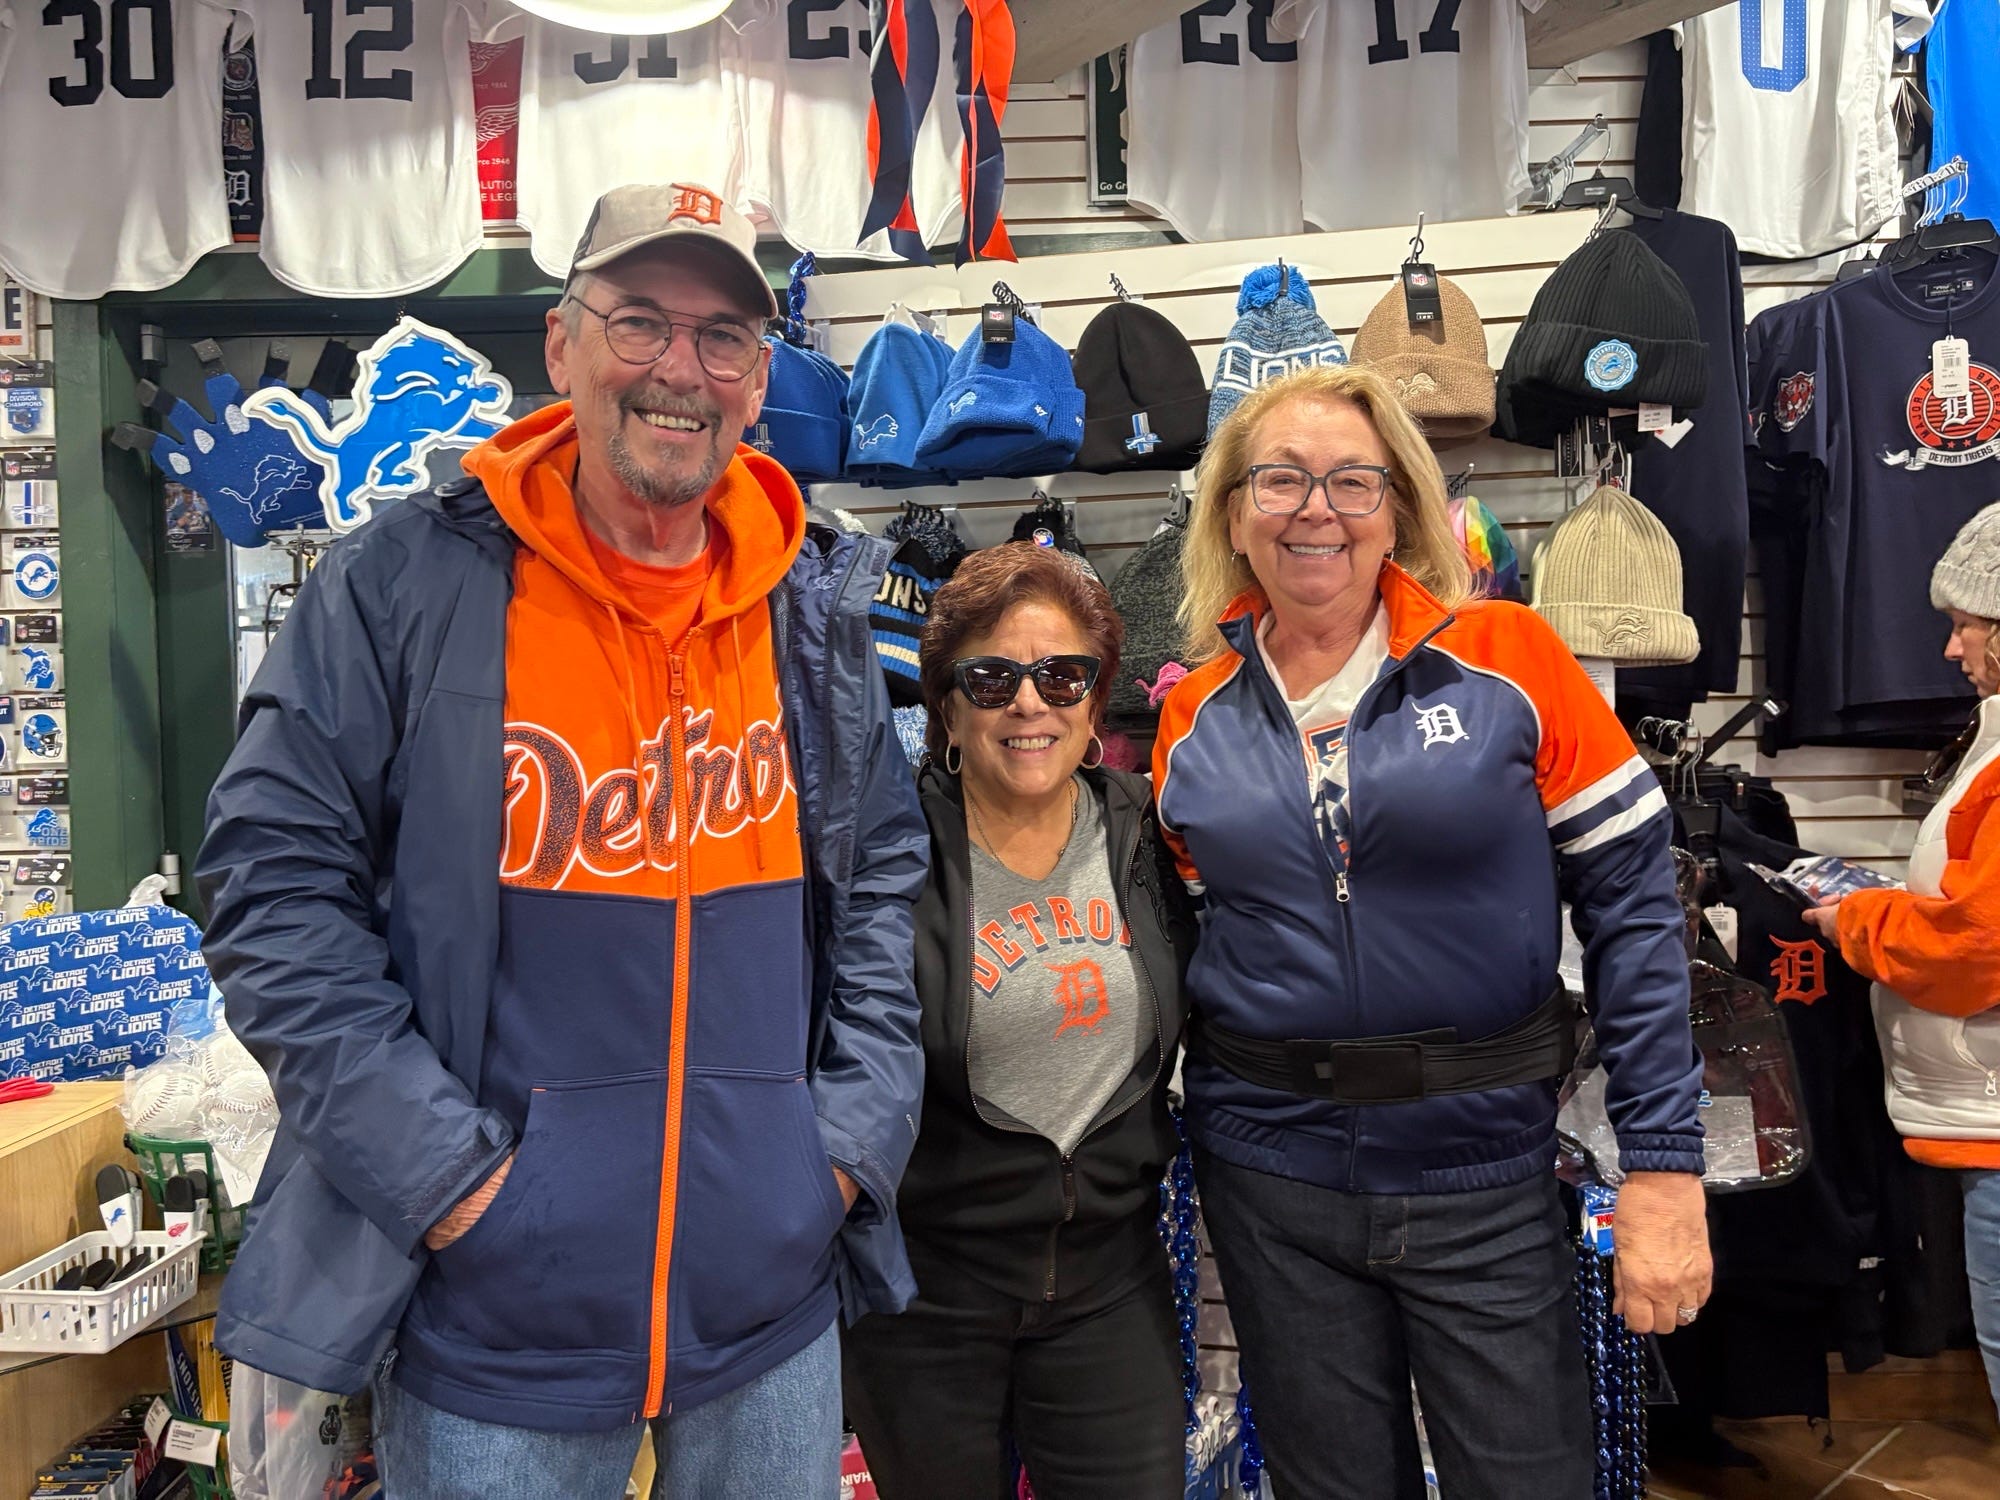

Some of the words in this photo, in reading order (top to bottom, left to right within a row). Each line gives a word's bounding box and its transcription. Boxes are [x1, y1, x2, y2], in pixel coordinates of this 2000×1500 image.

[43, 0, 174, 107] 30
[304, 0, 413, 102] 12
[480, 180, 516, 190] LUTIO
[1100, 181, 1113, 191] Go
[491, 192, 517, 202] LEGE
[1928, 451, 1962, 464] DETROIT
[1964, 445, 1994, 462] TIGERS
[1411, 702, 1470, 751] D
[500, 705, 798, 891] Detro
[105, 911, 149, 926] LIONS
[36, 920, 81, 937] LIONS
[154, 926, 186, 936] DETROIT
[86, 935, 120, 946] DETROIT
[143, 933, 186, 948] LIONS
[974, 896, 1132, 994] DETRO
[17, 945, 51, 957] DETROIT
[74, 941, 119, 959] LIONS
[4, 952, 50, 972] LIONS
[123, 957, 157, 968] DETROIT
[178, 956, 207, 970] LIO
[1769, 933, 1828, 1006] D
[54, 967, 88, 979] DETROIT
[112, 963, 156, 981] LIONS
[42, 974, 88, 993] LIONS
[160, 979, 192, 989] DETROIT
[92, 989, 126, 1000] DETROIT
[149, 985, 192, 1003] LIONS
[1043, 957, 1111, 1041] D
[24, 1001, 57, 1013] DETROIT
[80, 996, 125, 1015] LIONS
[12, 1009, 56, 1028] LIONS
[130, 1011, 163, 1022] DETROIT
[61, 1023, 95, 1035] DETROIT
[118, 1018, 162, 1036] LIONS
[0, 1037, 26, 1049] ETROIT
[49, 1031, 94, 1049] LIONS
[0, 1044, 25, 1060] ONS
[87, 1051, 132, 1067] LIONS
[177, 1352, 203, 1417] PISTONS
[841, 1471, 872, 1486] HAIN
